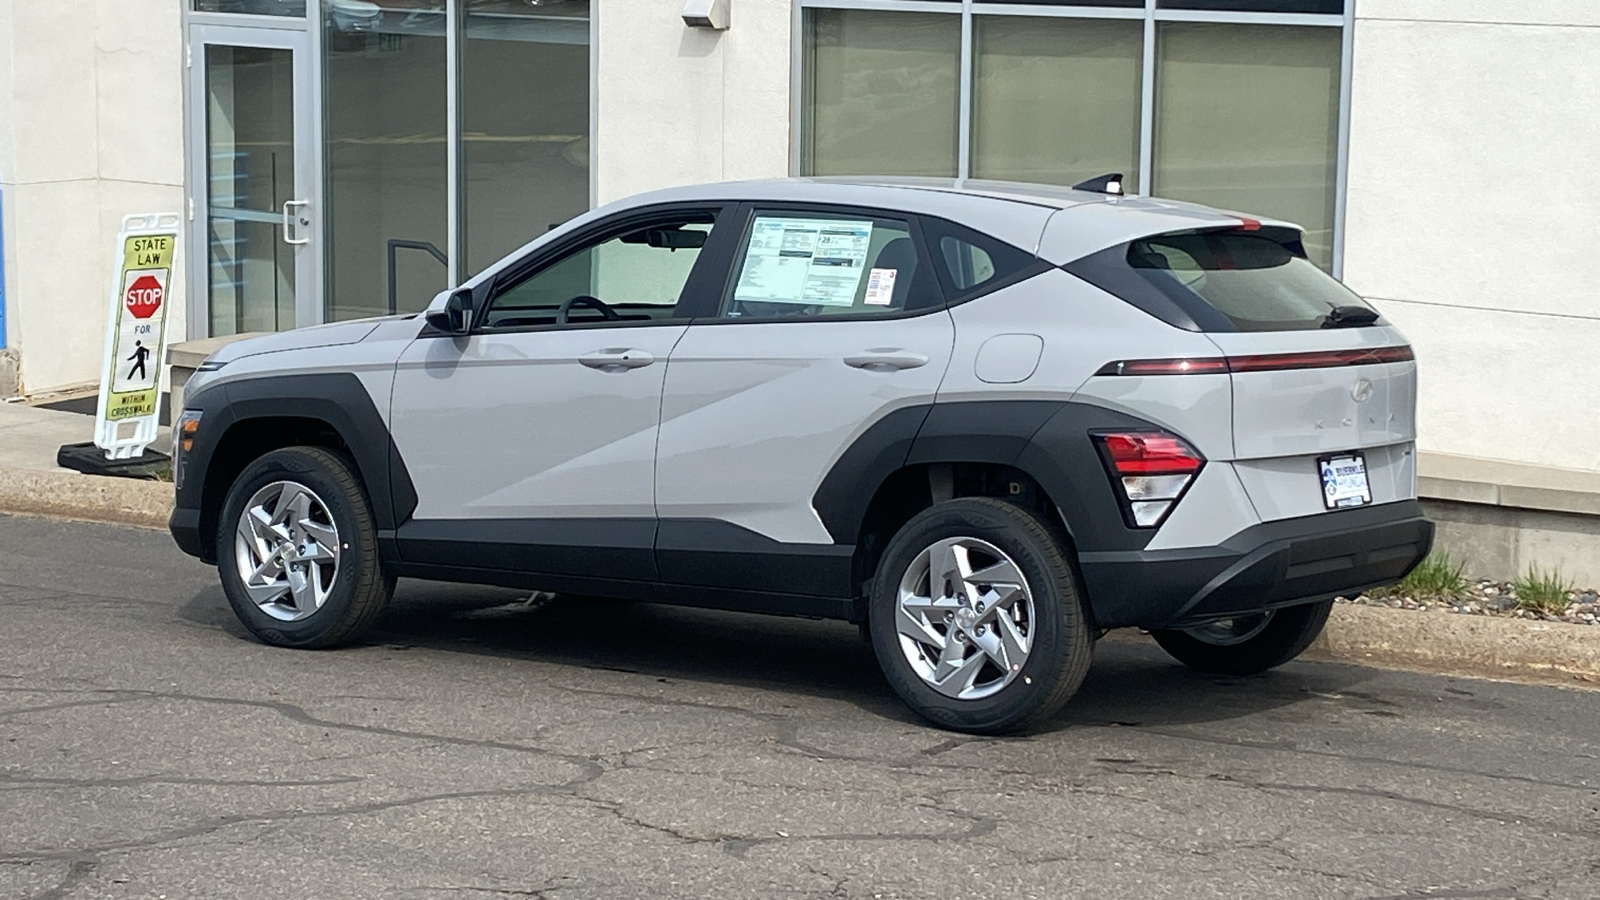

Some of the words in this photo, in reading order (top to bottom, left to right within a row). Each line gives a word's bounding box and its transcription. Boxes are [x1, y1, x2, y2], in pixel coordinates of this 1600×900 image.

[134, 239, 166, 252] STATE
[137, 253, 161, 266] LAW
[127, 288, 162, 306] STOP
[134, 325, 151, 334] FOR
[122, 394, 145, 404] WITHIN
[112, 405, 151, 417] CROSSWALK
